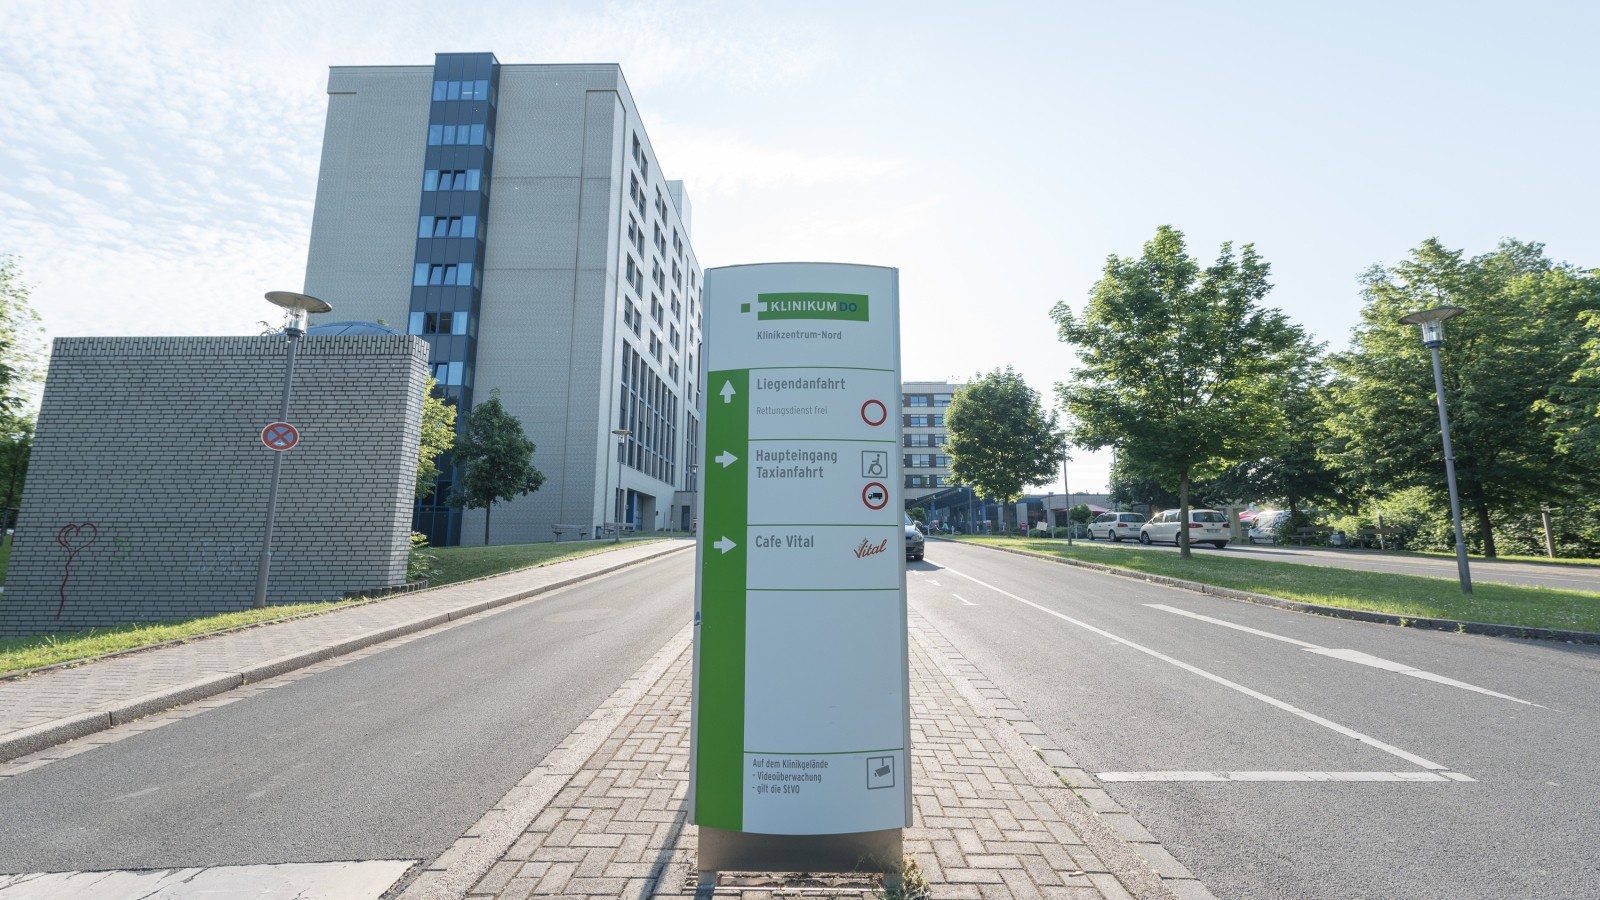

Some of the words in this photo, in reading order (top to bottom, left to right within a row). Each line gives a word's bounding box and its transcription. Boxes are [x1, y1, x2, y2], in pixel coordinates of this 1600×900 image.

[757, 330, 842, 340] Klinikzentrum-Nord
[757, 378, 846, 392] Liegendanfahrt
[756, 406, 812, 416] Rettungsdienst
[814, 406, 828, 415] frei
[756, 449, 838, 464] Haupteingang
[756, 466, 824, 478] Taxianfahrt
[755, 535, 782, 548] Cafe
[786, 535, 814, 548] Vital
[853, 537, 888, 559] Vital
[752, 759, 764, 768] Auf
[766, 759, 780, 768] dem
[782, 759, 829, 770] Klinikgelände
[757, 771, 822, 783] Videoüberwachung
[757, 784, 769, 795] gilt
[770, 784, 781, 794] die
[783, 784, 800, 794] StVO
